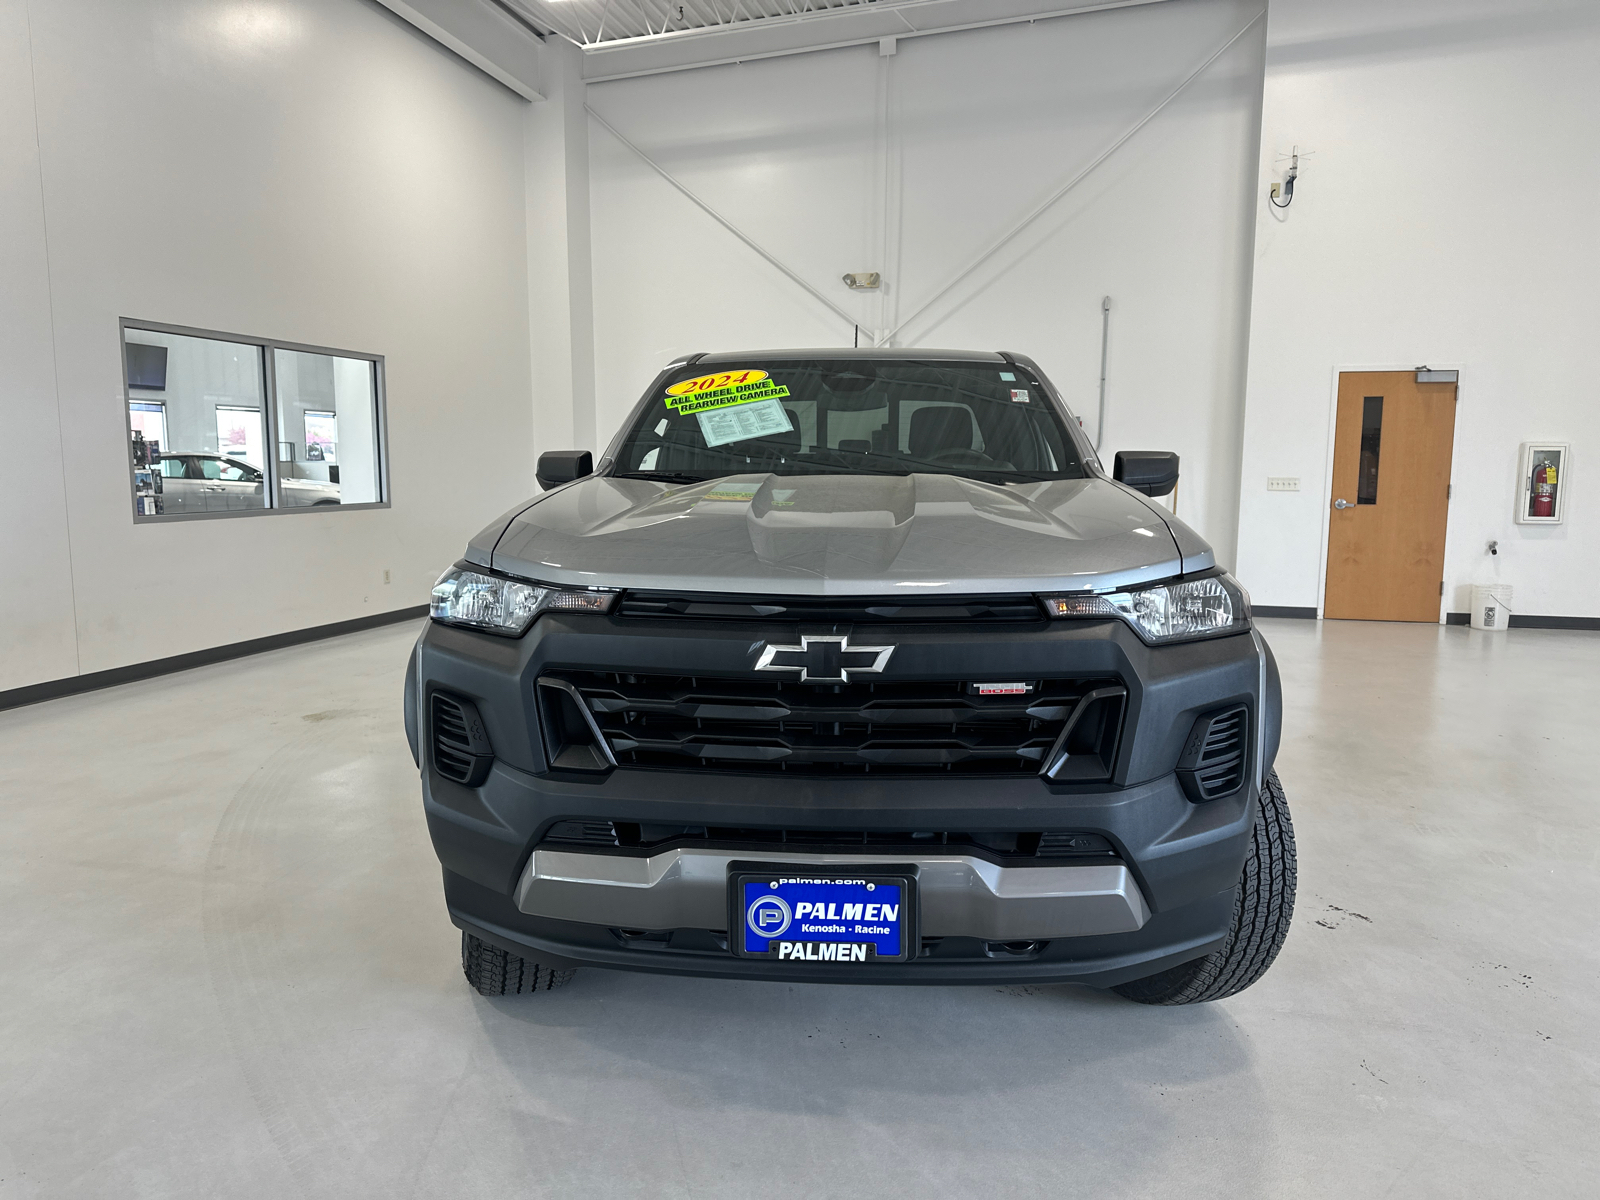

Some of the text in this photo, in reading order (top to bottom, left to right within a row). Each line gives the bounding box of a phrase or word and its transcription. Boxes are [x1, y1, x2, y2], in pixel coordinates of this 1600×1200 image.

[681, 371, 751, 395] 2024
[669, 381, 769, 407] ALL WHEEL DRIVE
[739, 387, 786, 402] CAMERA
[779, 877, 866, 886] palmen.com
[794, 901, 899, 922] PALMEN
[801, 923, 846, 934] Kenosha
[854, 924, 891, 935] Racine
[778, 941, 867, 962] PALMEN
